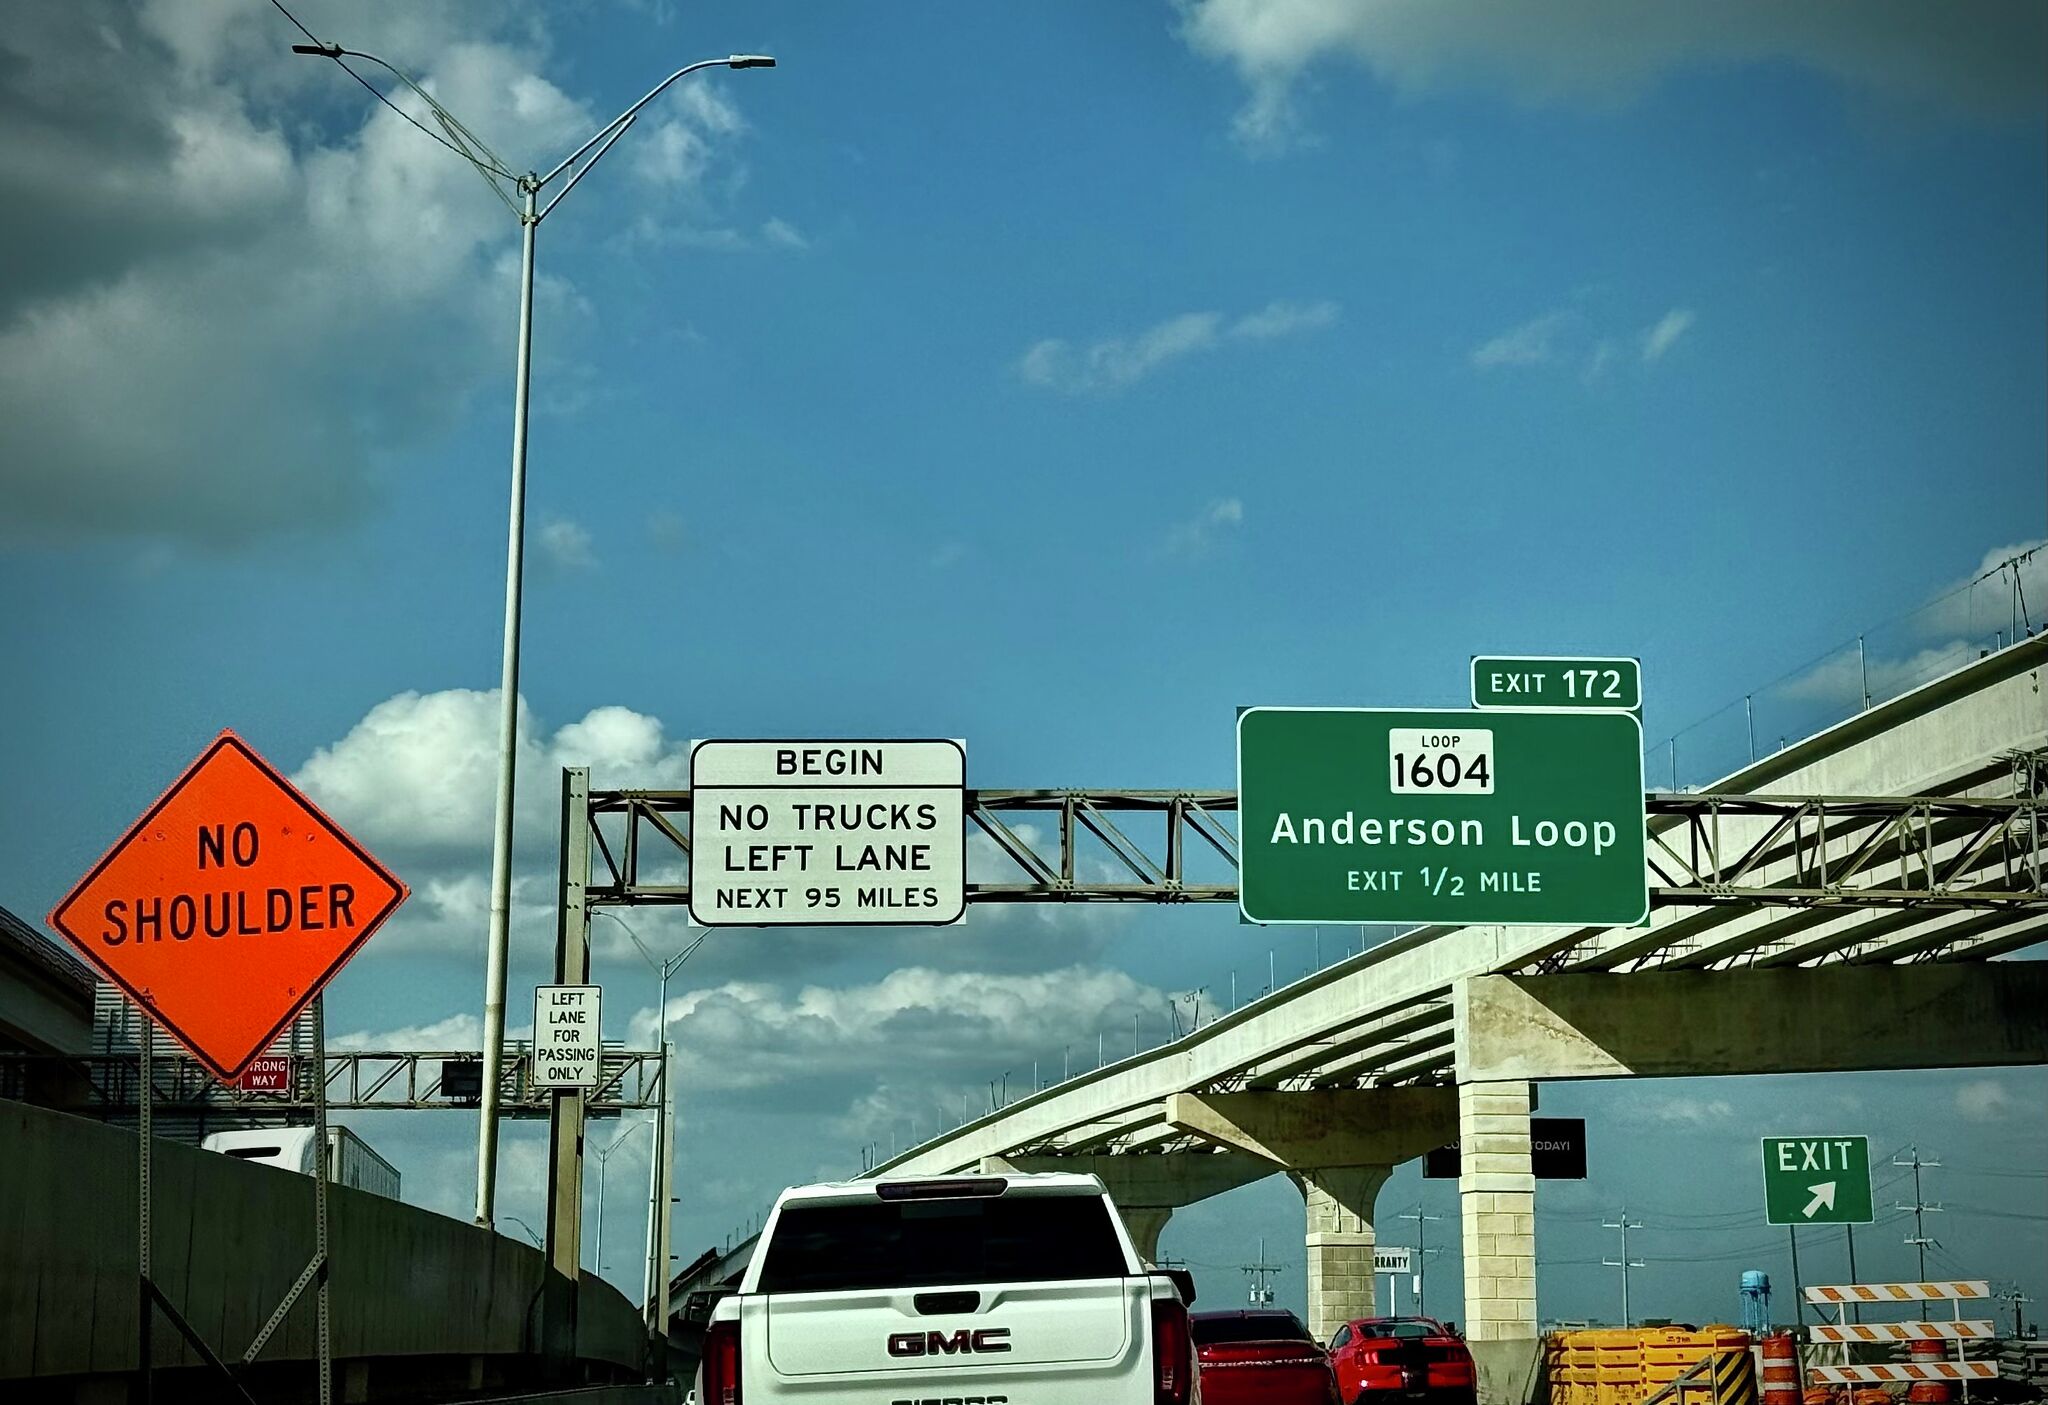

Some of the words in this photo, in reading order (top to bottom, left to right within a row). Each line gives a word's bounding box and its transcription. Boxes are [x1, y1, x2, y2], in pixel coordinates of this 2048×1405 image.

[1491, 673, 1546, 694] EXIT
[1562, 669, 1622, 698] 172
[1421, 735, 1461, 748] LOOP
[776, 749, 883, 775] BEGIN
[1394, 752, 1490, 788] 1604
[719, 804, 769, 831] NO
[791, 803, 937, 830] TRUCKS
[198, 821, 259, 870] NO
[1270, 811, 1484, 846] Anderson
[1511, 815, 1617, 856] Loop
[725, 845, 814, 872] LEFT
[835, 844, 931, 871] LANE
[1347, 870, 1403, 892] EXIT
[1420, 866, 1465, 897] 1/2
[1480, 871, 1542, 893] MILE
[716, 888, 789, 909] NEXT
[805, 887, 841, 908] 95
[857, 887, 939, 908] MILES
[102, 883, 355, 946] SHOULDER
[551, 992, 585, 1006] LEFT
[549, 1011, 586, 1024] LANE
[553, 1029, 580, 1043] FOR
[538, 1048, 595, 1062] PASSING
[252, 1075, 277, 1086] WAY
[548, 1066, 584, 1080] ONLY
[1777, 1141, 1852, 1171] EXIT
[887, 1327, 1012, 1358] GMC
